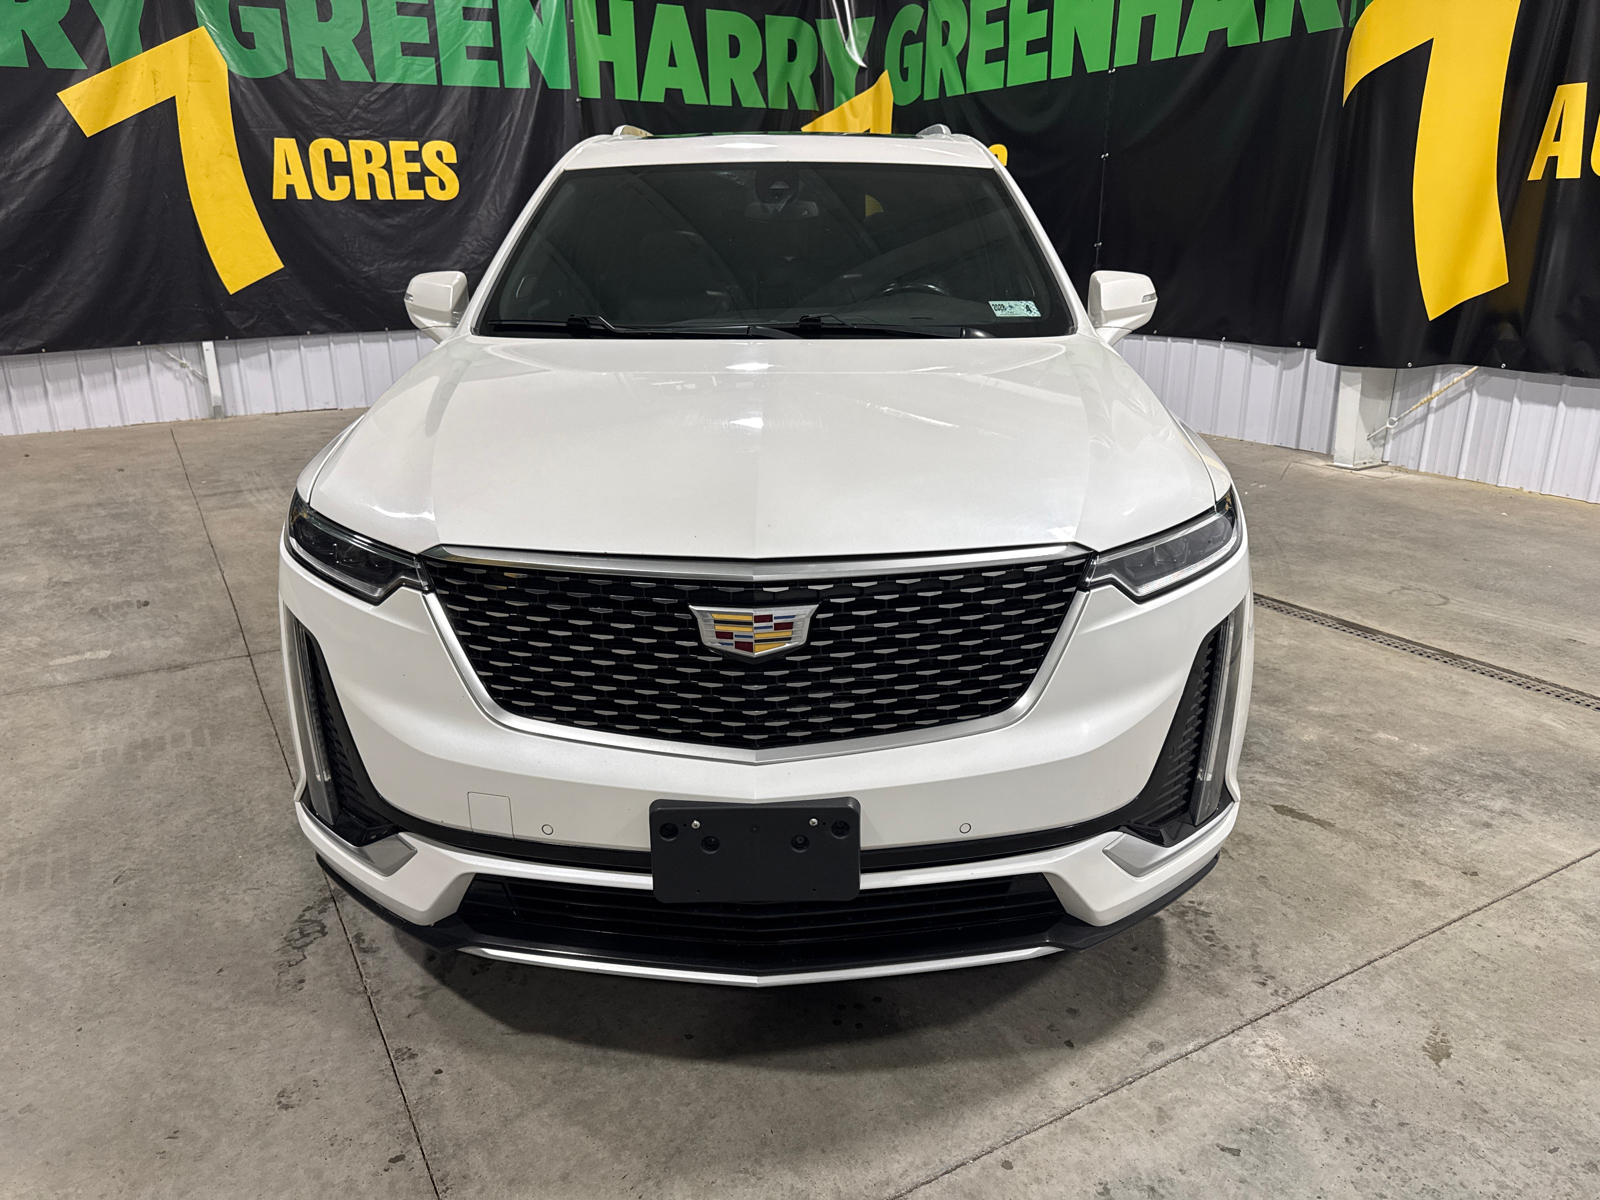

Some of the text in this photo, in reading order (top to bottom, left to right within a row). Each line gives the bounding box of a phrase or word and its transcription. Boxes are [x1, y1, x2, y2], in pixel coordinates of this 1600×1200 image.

[194, 0, 571, 89] GREEN
[572, 0, 876, 111] HARRY
[884, 0, 1114, 106] GREEN
[57, 26, 460, 294] 7 ACRES
